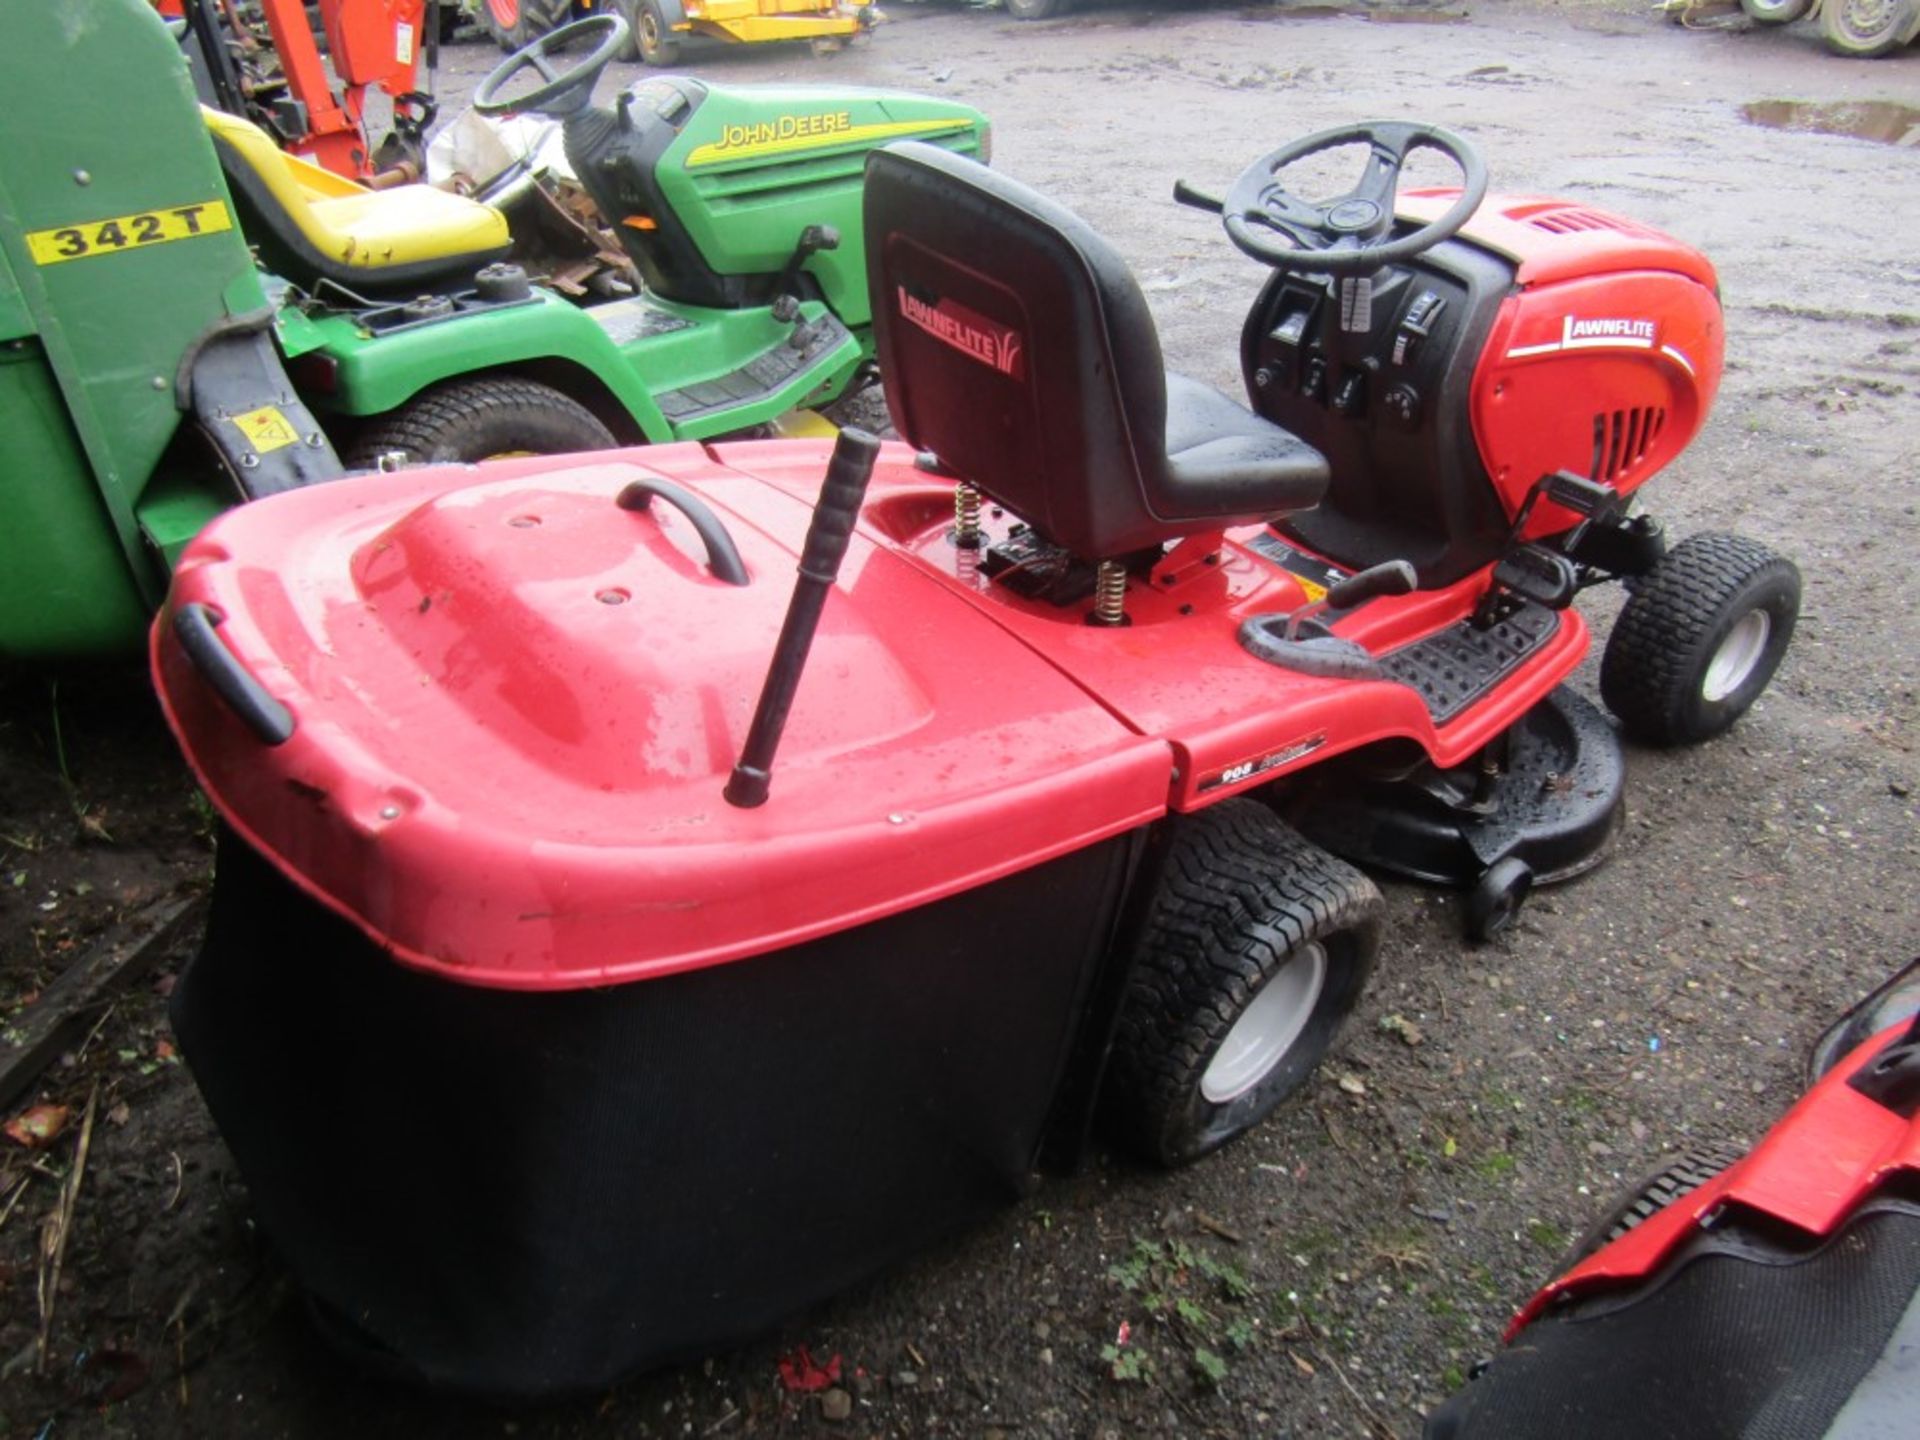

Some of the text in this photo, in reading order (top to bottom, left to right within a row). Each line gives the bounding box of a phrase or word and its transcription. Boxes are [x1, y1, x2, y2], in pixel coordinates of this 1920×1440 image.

[715, 112, 851, 150] JOHN DEERE
[898, 285, 995, 366] LAWNFLITE
[1562, 315, 1654, 349] LAWNFLITE
